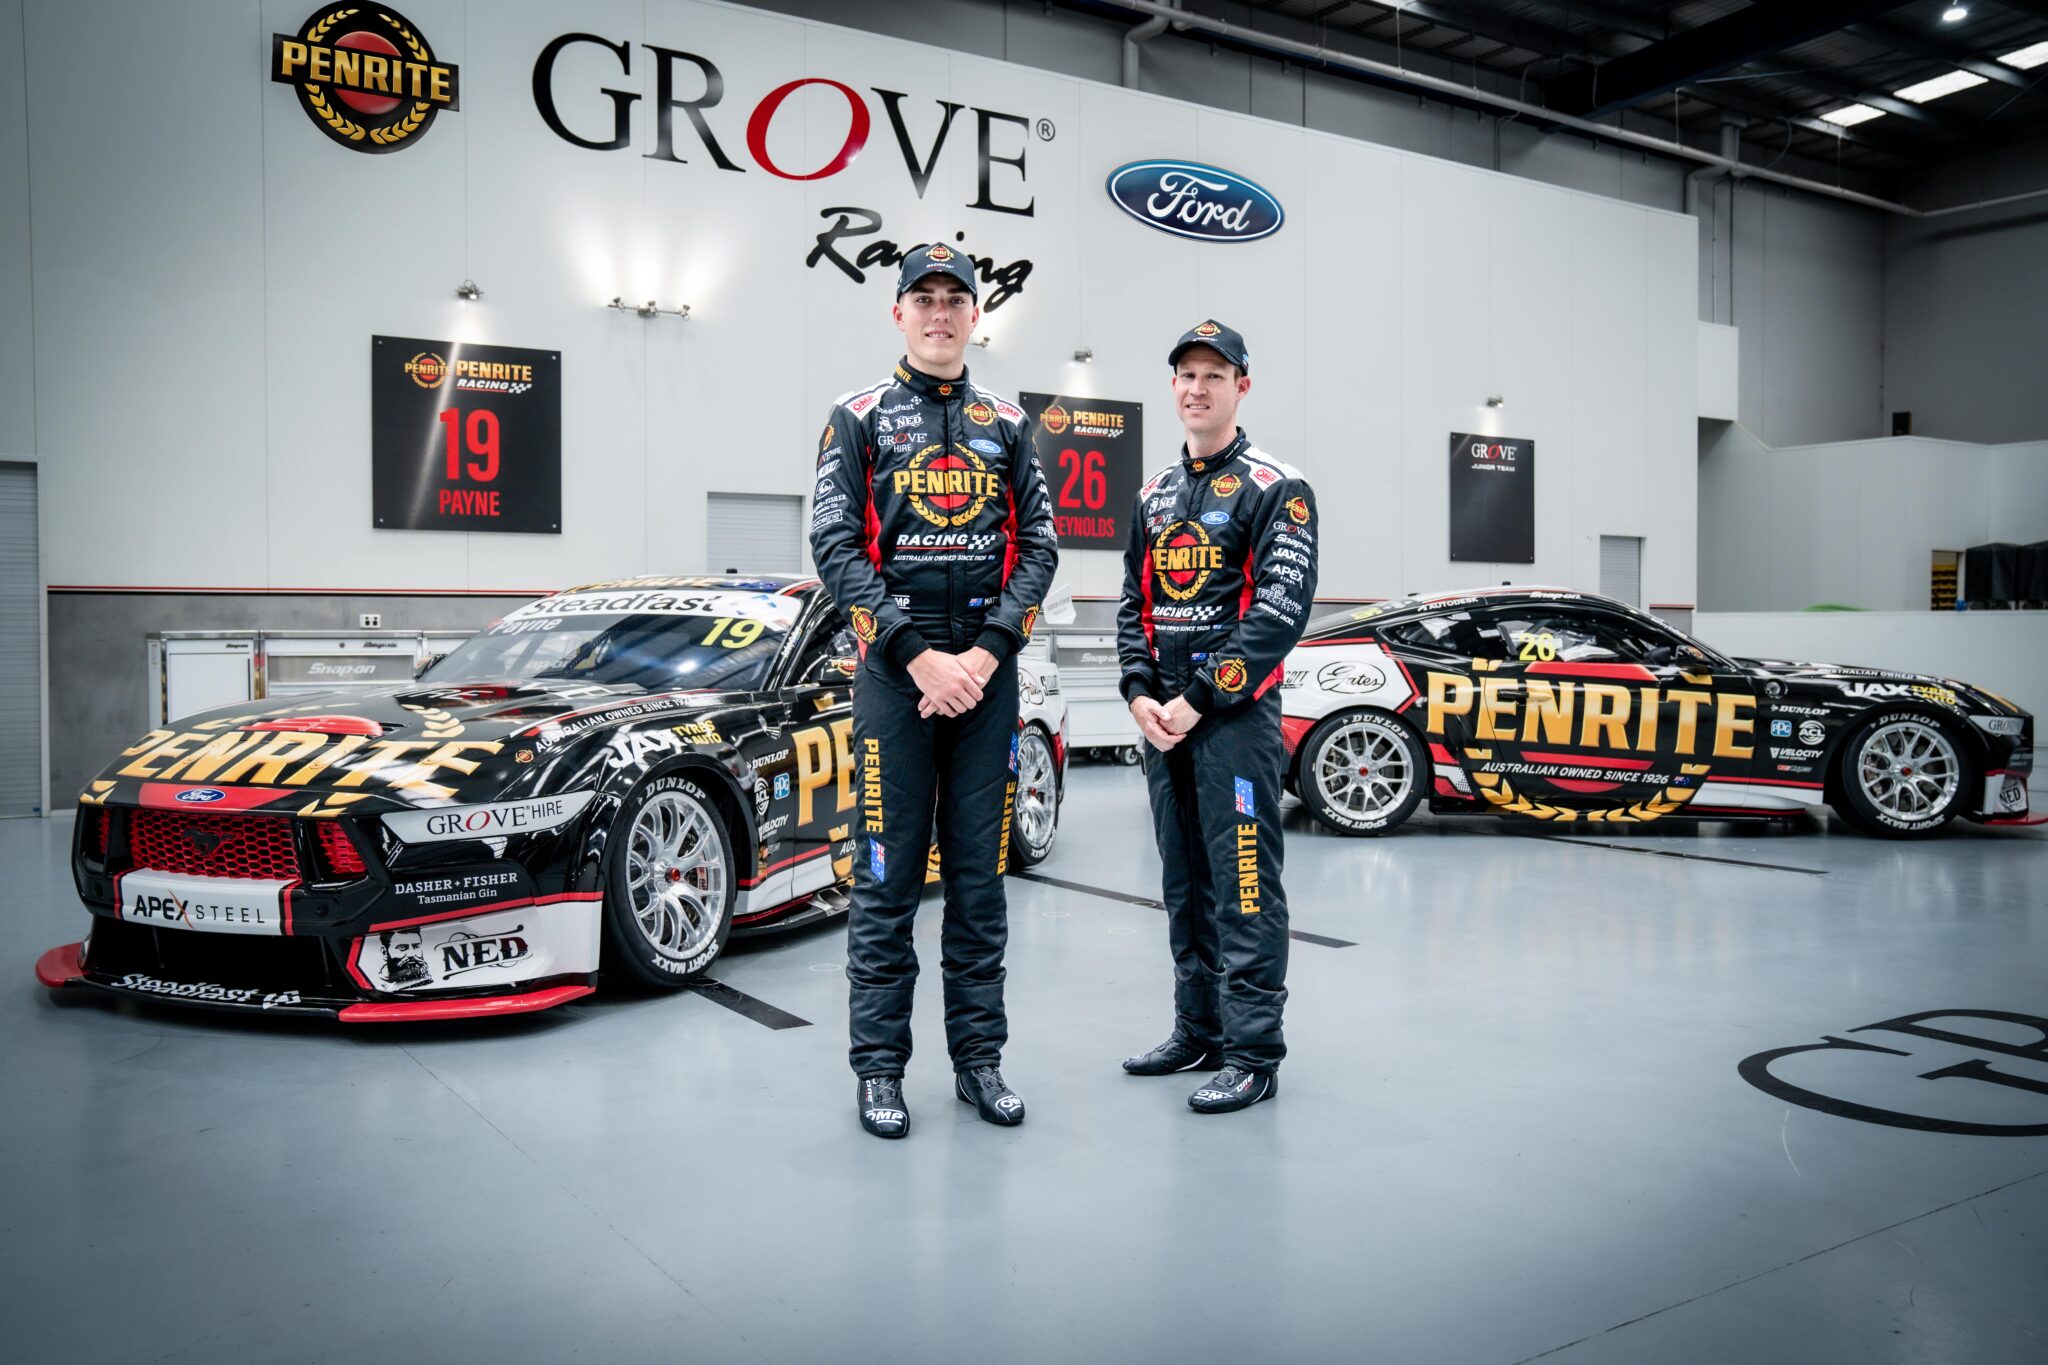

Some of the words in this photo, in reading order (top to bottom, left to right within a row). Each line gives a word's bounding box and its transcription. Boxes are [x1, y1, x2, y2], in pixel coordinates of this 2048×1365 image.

[281, 40, 451, 102] PENRITE
[1146, 171, 1253, 233] Ford
[806, 206, 1033, 313] Rang
[404, 362, 451, 376] PENRITE
[456, 360, 532, 382] PENRITE
[456, 379, 509, 391] RACING
[875, 403, 915, 415] Steadfast
[1040, 412, 1071, 425] PENRITE
[1073, 410, 1124, 428] PENRITE
[1073, 426, 1109, 436] RACING
[440, 407, 500, 482] 19
[893, 444, 912, 453] HIRE
[1256, 469, 1276, 482] OMP
[1497, 464, 1515, 472] TEAM
[893, 469, 999, 497] PENRITE
[1058, 448, 1107, 510] 26
[439, 489, 500, 516] PAYNE
[896, 533, 967, 547] RACING
[1273, 533, 1311, 556] Snap-on
[1272, 547, 1299, 562] JAX
[1272, 563, 1304, 584] APEX
[522, 592, 722, 617] Steadfast
[1152, 606, 1194, 618] RACING
[1428, 597, 1479, 610] AUTODESK
[488, 618, 563, 636] Payne
[700, 617, 766, 649] 19
[849, 604, 876, 644] PENRITE
[1519, 632, 1557, 662] 26
[308, 662, 376, 677] Snap-on
[1880, 671, 1914, 680] OWNED
[1844, 683, 1912, 697] JAX
[1426, 671, 1758, 760] PENRITE
[1779, 705, 1831, 716] DUNLOP
[1879, 712, 1941, 729] DUNLOP
[536, 714, 605, 753] AUSTRALIAN
[607, 705, 643, 721] OWNED
[643, 700, 674, 713] SINCE
[672, 719, 716, 736] TYRES
[1352, 713, 1409, 741] DUNLOP
[1772, 722, 1790, 735] PPG
[1799, 728, 1825, 737] ACL
[608, 728, 687, 769] JAX
[692, 732, 722, 745] AUTO
[752, 749, 790, 770] DUNLOP
[1779, 748, 1824, 758] VELOCITY
[121, 729, 505, 801] PENRITE
[1481, 761, 1557, 777] AUSTRALIAN
[1560, 766, 1602, 780] OWNED
[1603, 770, 1639, 783] SINCE
[1641, 773, 1669, 785] 1926
[179, 789, 222, 802] Ford
[646, 776, 706, 799] DUNLOP
[775, 776, 790, 796] PPG
[864, 738, 884, 833] PENRITE
[755, 791, 770, 806] ACL
[531, 800, 563, 819] HIRE
[1321, 806, 1350, 826] MAXX
[1349, 816, 1388, 830] SPORT
[1875, 813, 1910, 831] MAXX
[1909, 814, 1946, 831] SPORT
[1237, 823, 1260, 914] PENRITE
[395, 879, 452, 895] DASHER
[464, 872, 518, 888] FISHER
[417, 889, 477, 905] Tasmanian
[478, 888, 498, 898] Gin
[133, 889, 194, 928] APEX
[196, 904, 265, 924] STEEL
[442, 936, 528, 972] NED
[652, 953, 687, 975] MAXX
[686, 938, 720, 974] SPORT
[111, 973, 258, 1002] Steadfast
